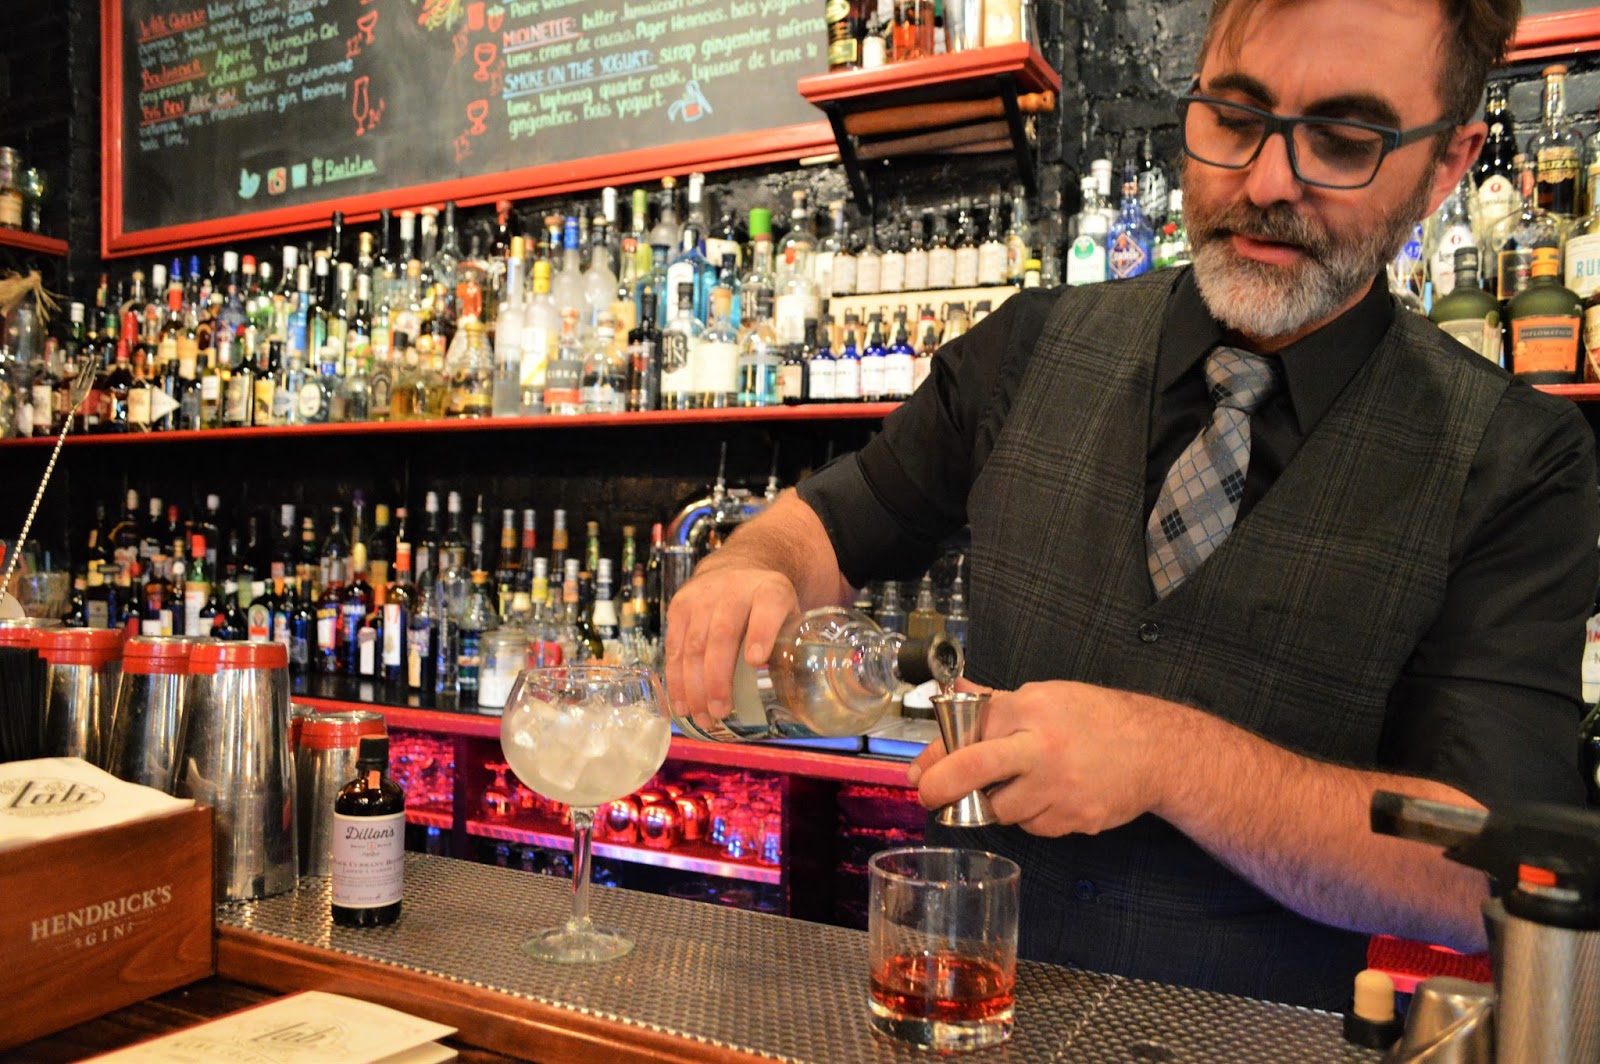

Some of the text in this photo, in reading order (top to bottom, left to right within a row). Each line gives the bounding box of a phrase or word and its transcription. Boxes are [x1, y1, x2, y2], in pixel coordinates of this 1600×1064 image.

[547, 65, 566, 84] ON
[568, 58, 594, 80] THE
[1538, 159, 1577, 171] RUZAN
[1576, 257, 1600, 279] RU
[345, 825, 395, 840] Dillon's
[30, 885, 172, 942] HENDRICK'S
[85, 924, 125, 946] GIN
